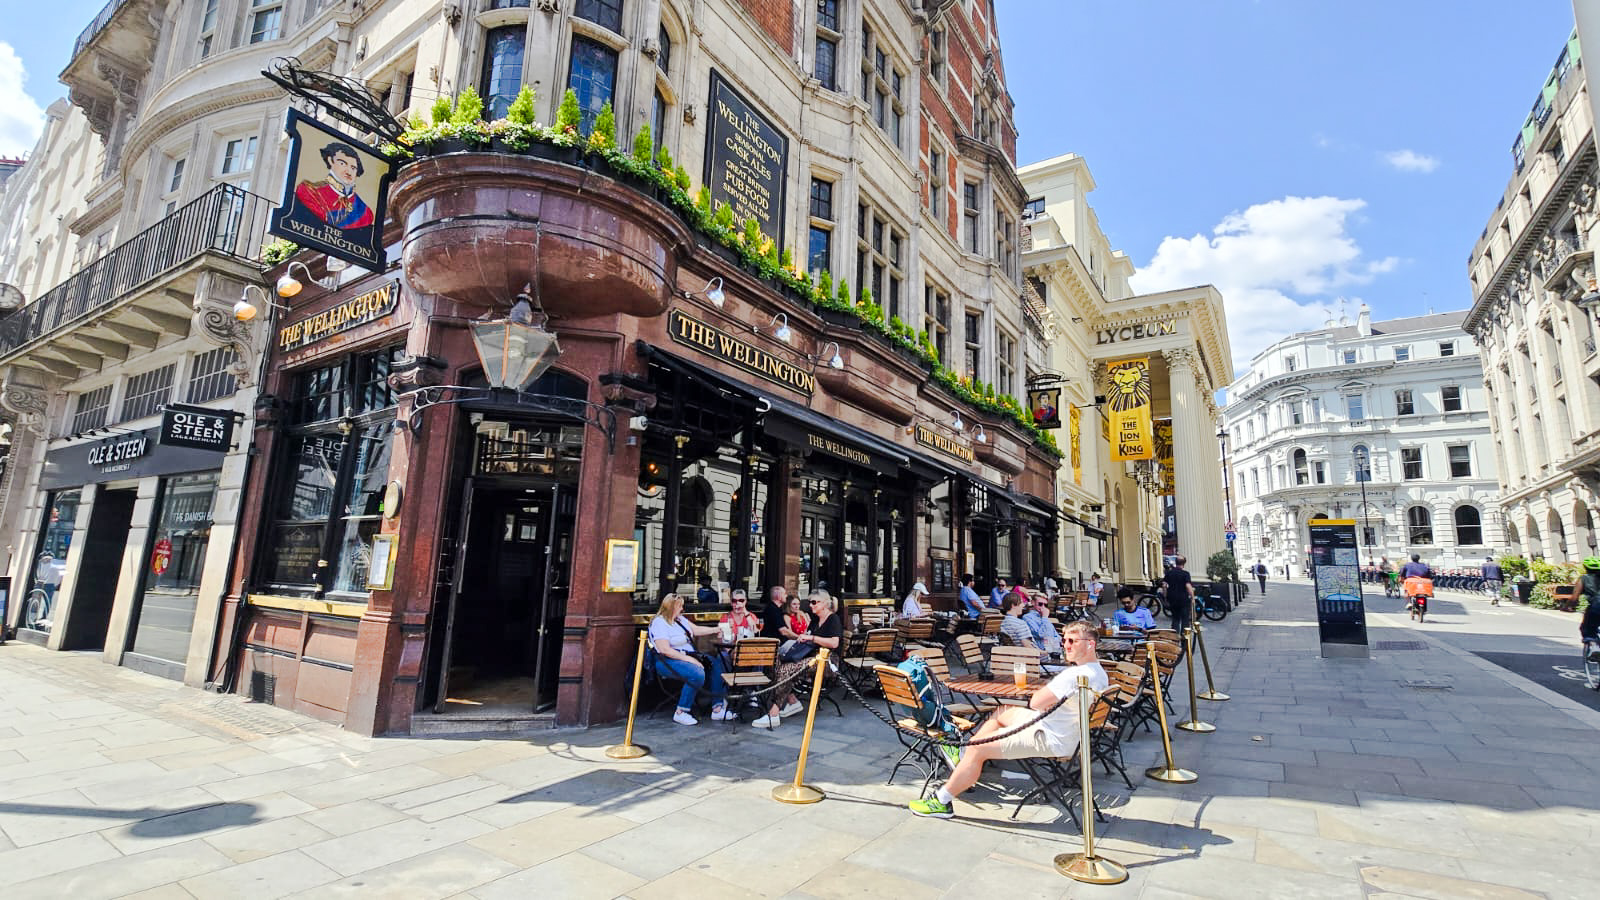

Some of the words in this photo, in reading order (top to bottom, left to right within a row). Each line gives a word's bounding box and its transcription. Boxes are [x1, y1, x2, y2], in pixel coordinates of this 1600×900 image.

[718, 100, 781, 166] WELLINGTON
[744, 111, 760, 133] THE
[725, 136, 750, 163] CASK
[750, 158, 772, 181] ALES
[734, 132, 766, 164] SEASONAL
[725, 159, 748, 180] GREAT
[747, 175, 770, 199] BRITISH
[725, 169, 745, 191] PUB
[745, 184, 769, 210] FOOD
[723, 182, 748, 205] SERVED
[748, 201, 758, 214] ALL
[759, 208, 770, 222] DAY
[736, 202, 744, 213] IN
[290, 219, 372, 258] WELLINGTON
[323, 224, 343, 238] THE
[280, 321, 303, 347] THE
[303, 284, 392, 337] WELLINGTON
[1095, 319, 1178, 345] LYCEUM
[677, 314, 716, 350] THE
[718, 333, 815, 393] WELLINGTON
[171, 423, 224, 440] STEEN
[173, 413, 206, 427] OLE
[213, 418, 224, 429] &
[1122, 421, 1137, 429] THE
[88, 444, 106, 465] OLE
[105, 444, 114, 462] &
[114, 438, 147, 461] STEEN
[807, 433, 825, 449] THE
[825, 440, 871, 465] WELLINGTON
[918, 427, 934, 444] THE
[934, 434, 974, 463] WELLINGTON
[1118, 443, 1144, 457] KING
[1119, 431, 1140, 443] LION
[184, 511, 207, 522] DANISH
